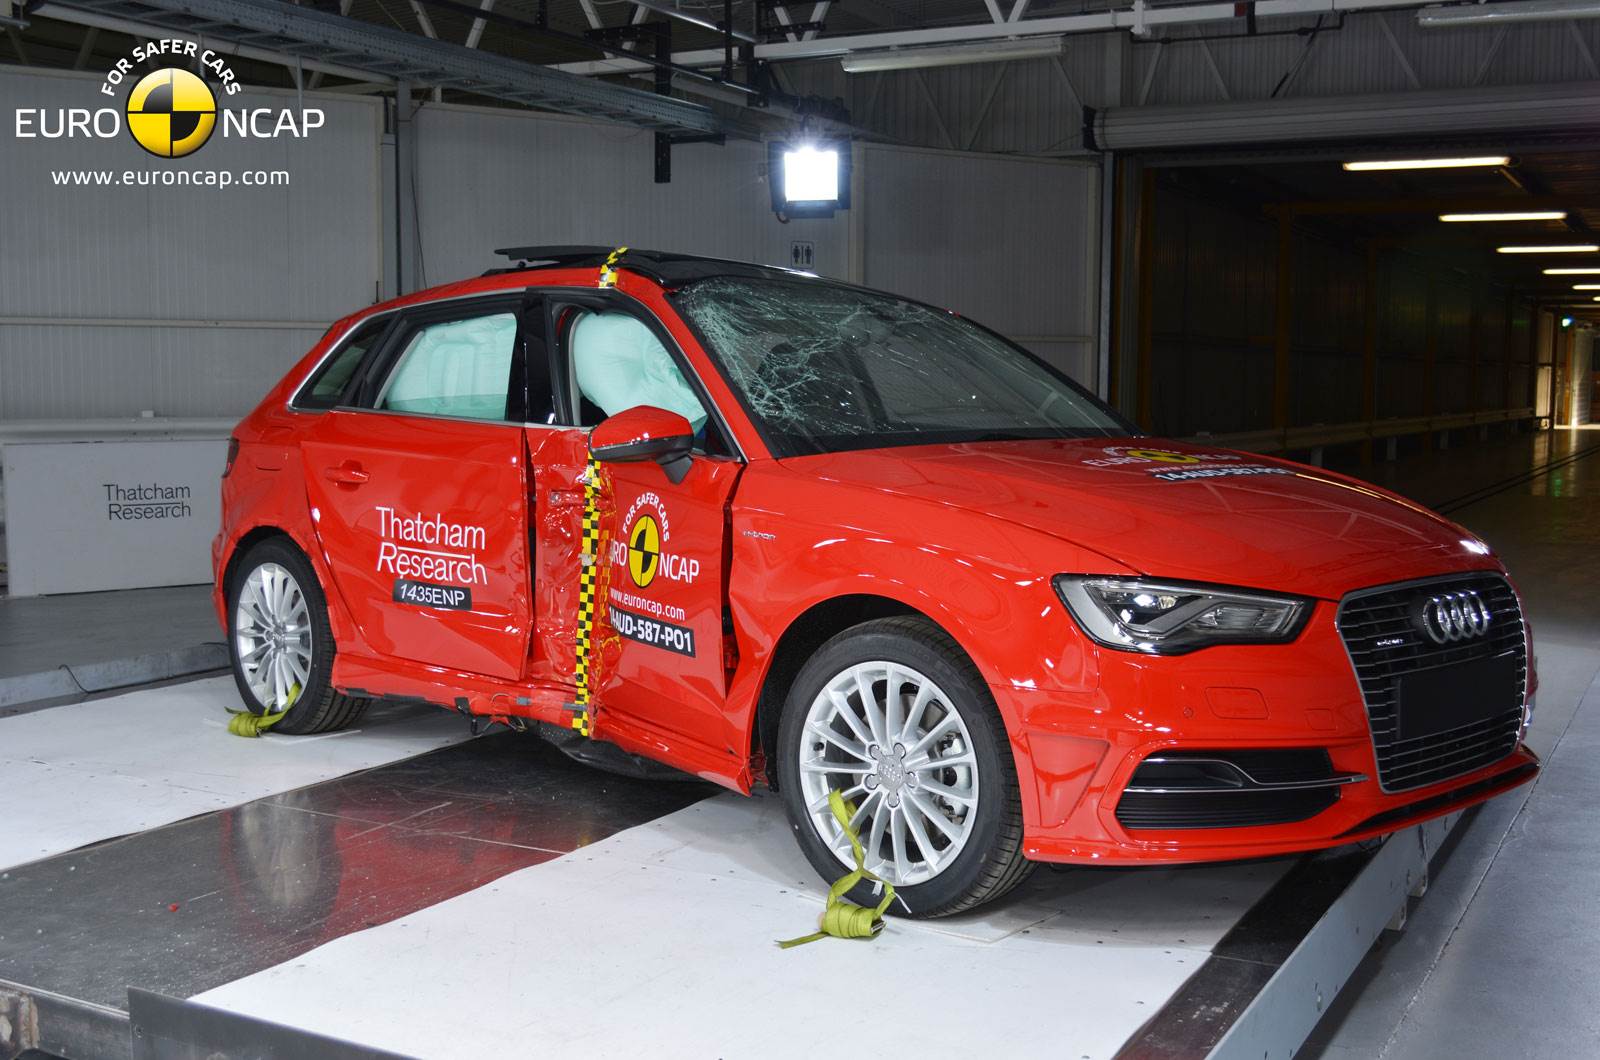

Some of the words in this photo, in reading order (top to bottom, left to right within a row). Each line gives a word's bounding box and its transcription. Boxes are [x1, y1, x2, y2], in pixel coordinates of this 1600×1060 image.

[103, 483, 191, 501] Thatcham
[108, 501, 192, 521] Research
[622, 504, 636, 533] FOR
[635, 492, 660, 510] SAFER
[658, 503, 670, 542] CARS
[376, 506, 486, 550] Thatcham
[377, 542, 488, 586] Research
[659, 552, 699, 583] NCAP
[400, 583, 465, 606] 1435ENP
[609, 588, 686, 621] www.euroncap.com
